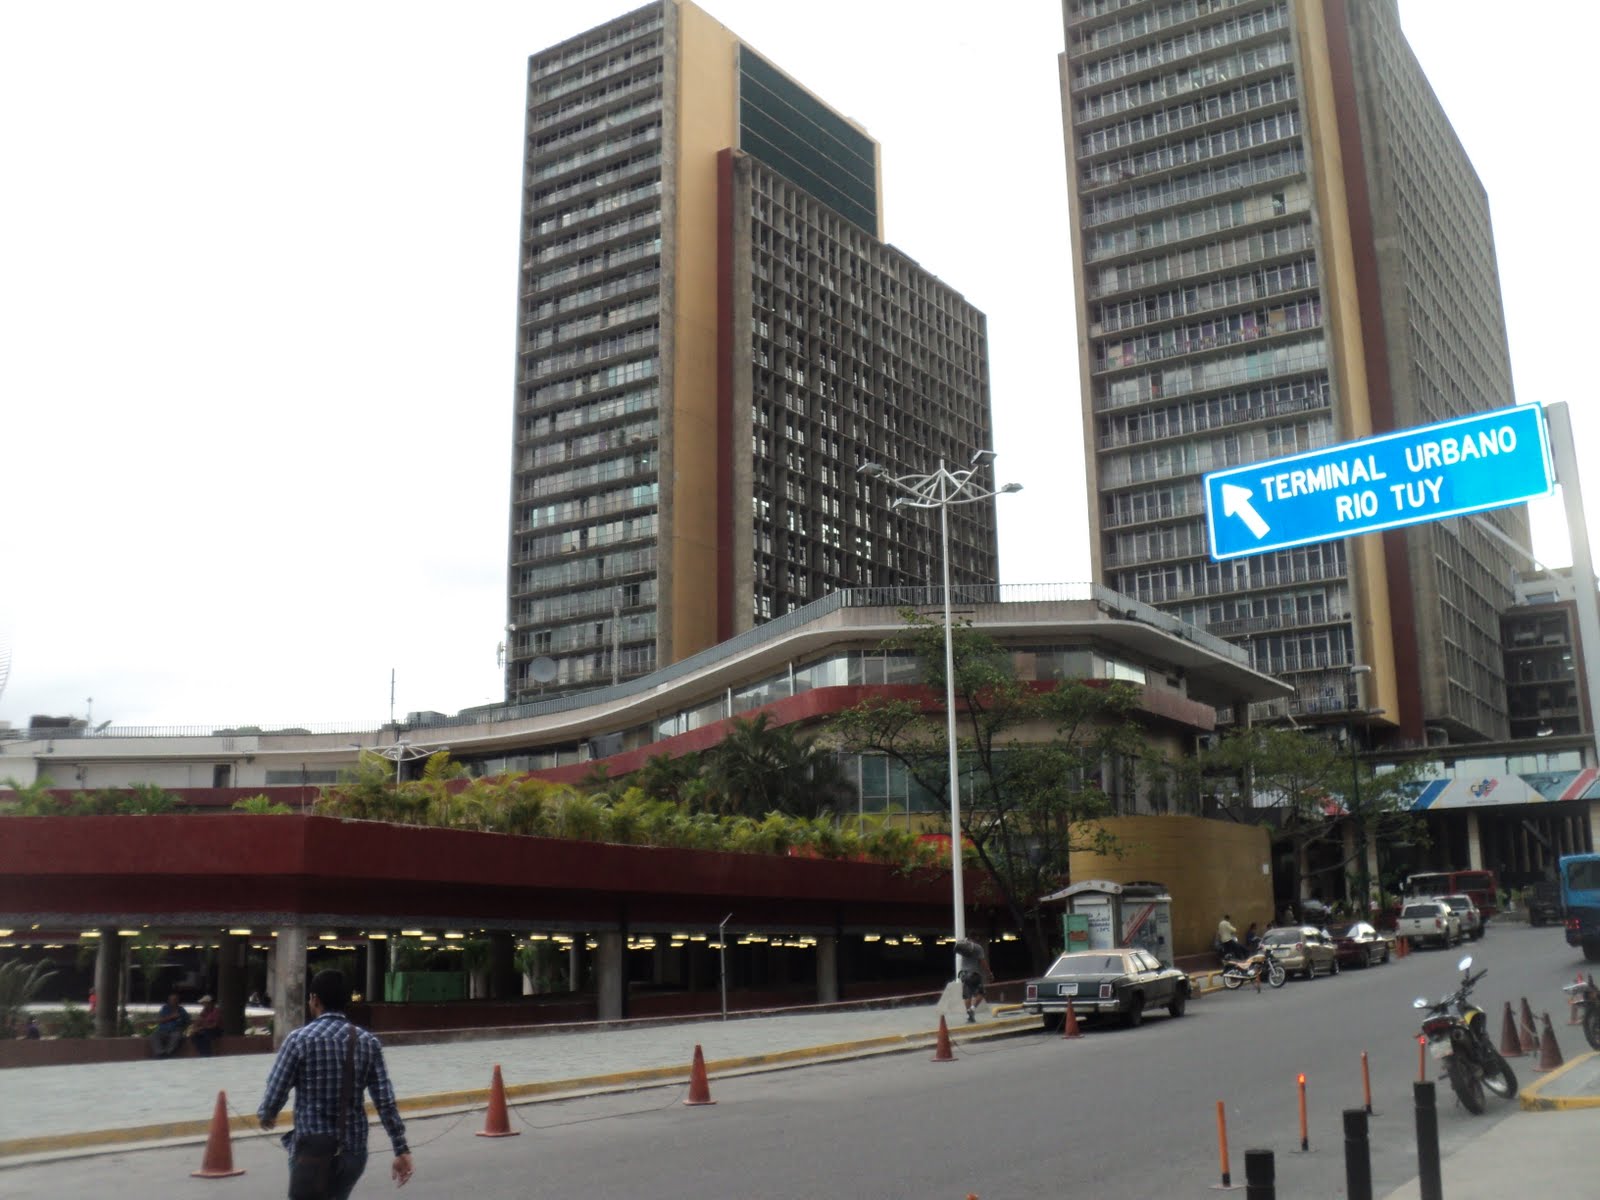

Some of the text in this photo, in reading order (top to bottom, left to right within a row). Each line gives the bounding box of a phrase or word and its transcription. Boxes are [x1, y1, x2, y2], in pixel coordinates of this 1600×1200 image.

[1261, 426, 1517, 502] TERMINAL URBANO
[1335, 476, 1444, 522] RIO TUY
